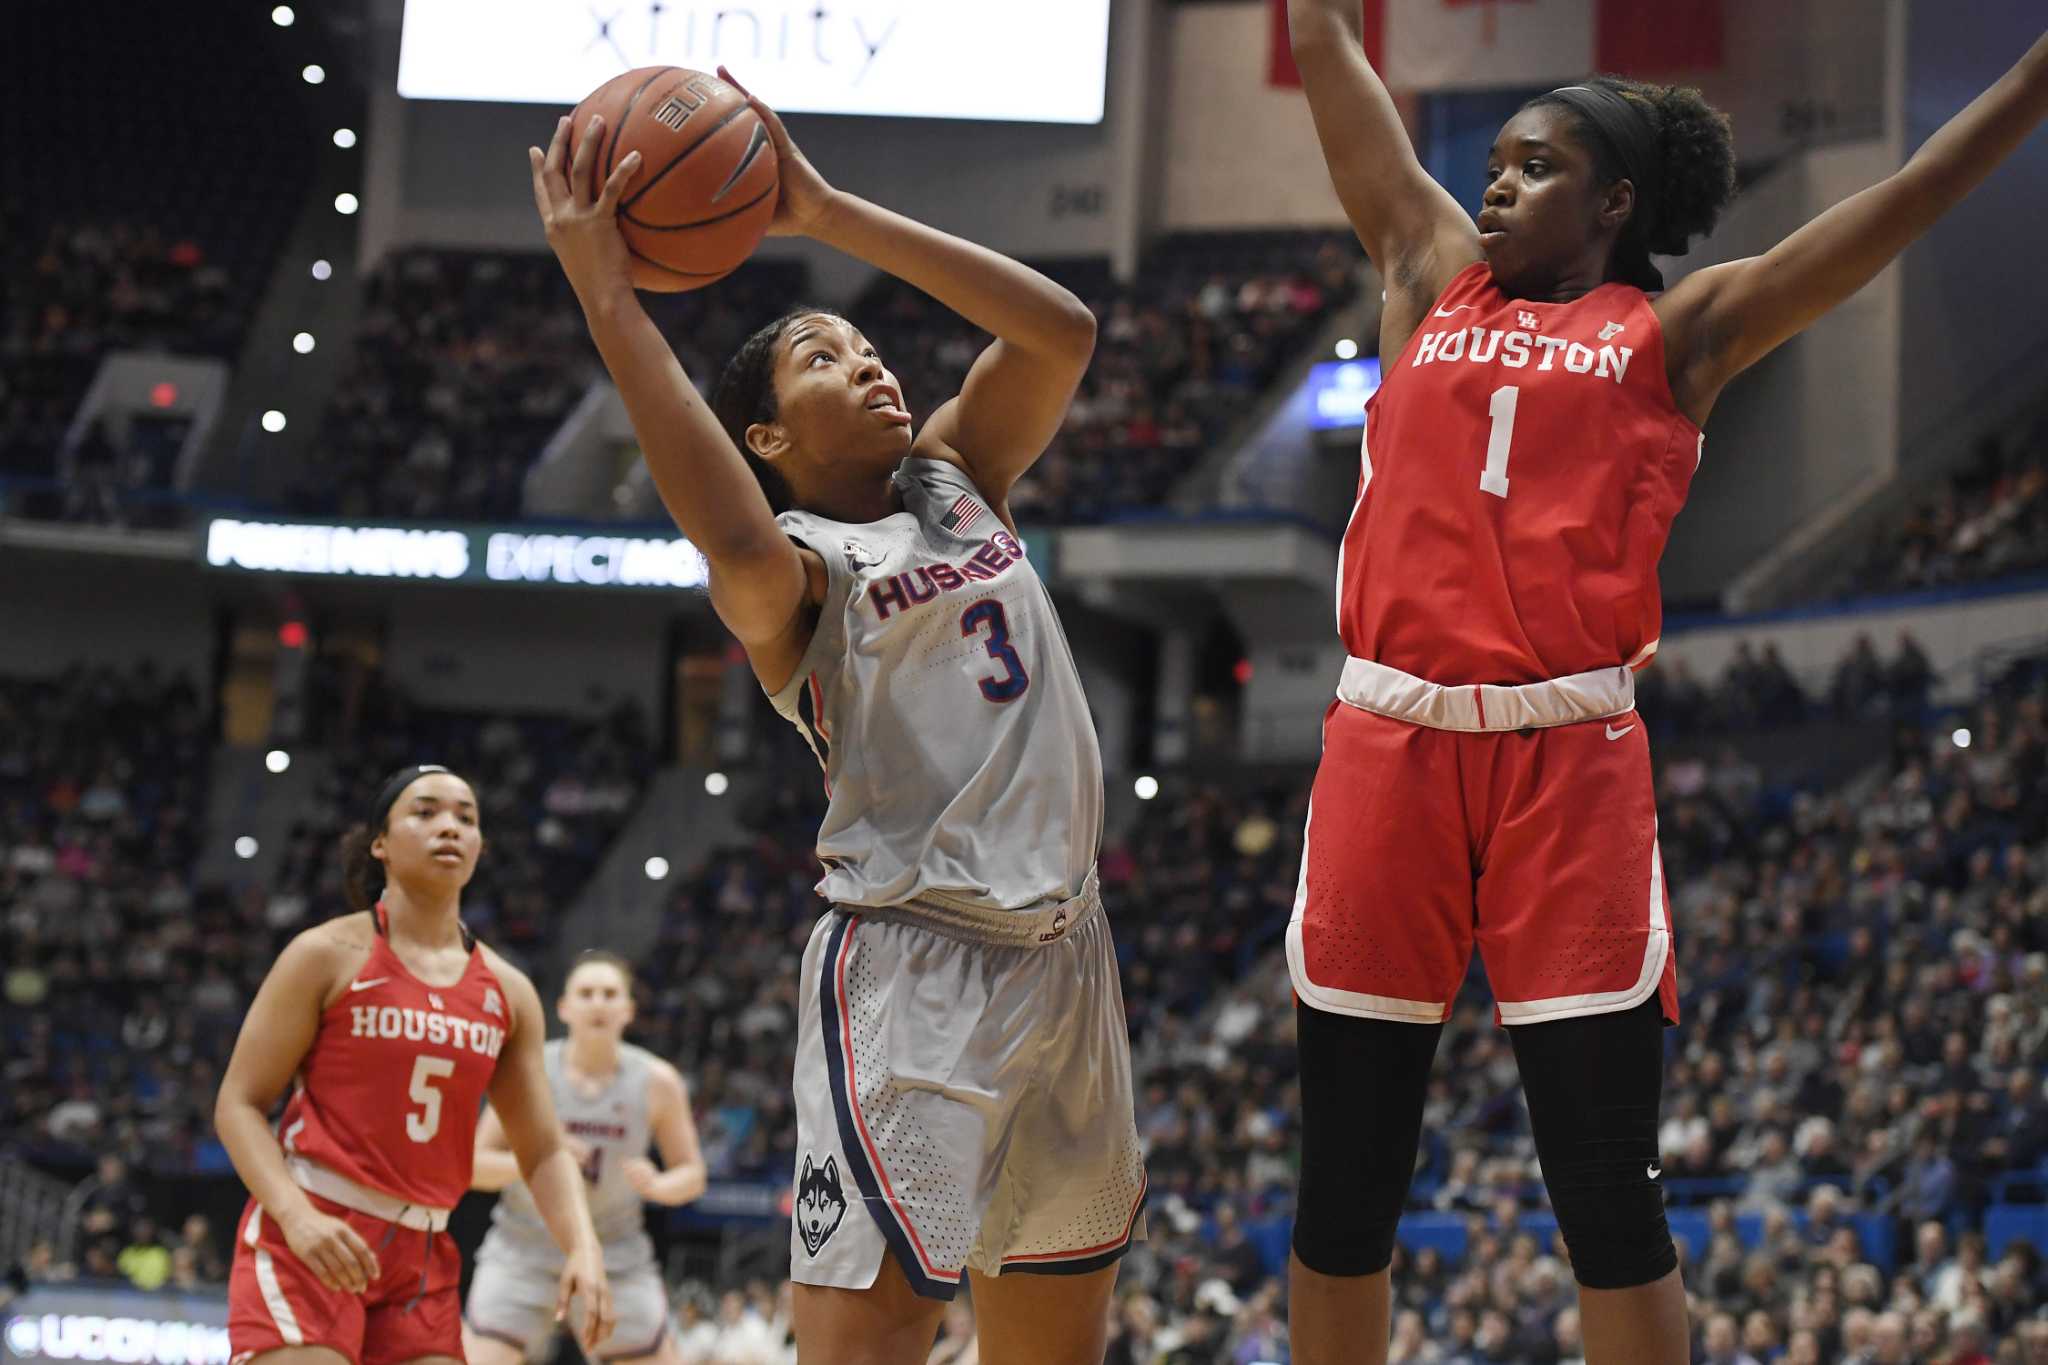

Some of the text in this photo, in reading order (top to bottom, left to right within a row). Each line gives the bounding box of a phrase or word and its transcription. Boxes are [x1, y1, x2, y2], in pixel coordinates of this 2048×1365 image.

[582, 0, 898, 87] xfinity
[1412, 326, 1633, 384] HOUSTON
[1479, 385, 1519, 499] 1
[960, 598, 1029, 703] 3
[351, 1006, 505, 1059] HOUSTON
[406, 1055, 456, 1143] 5
